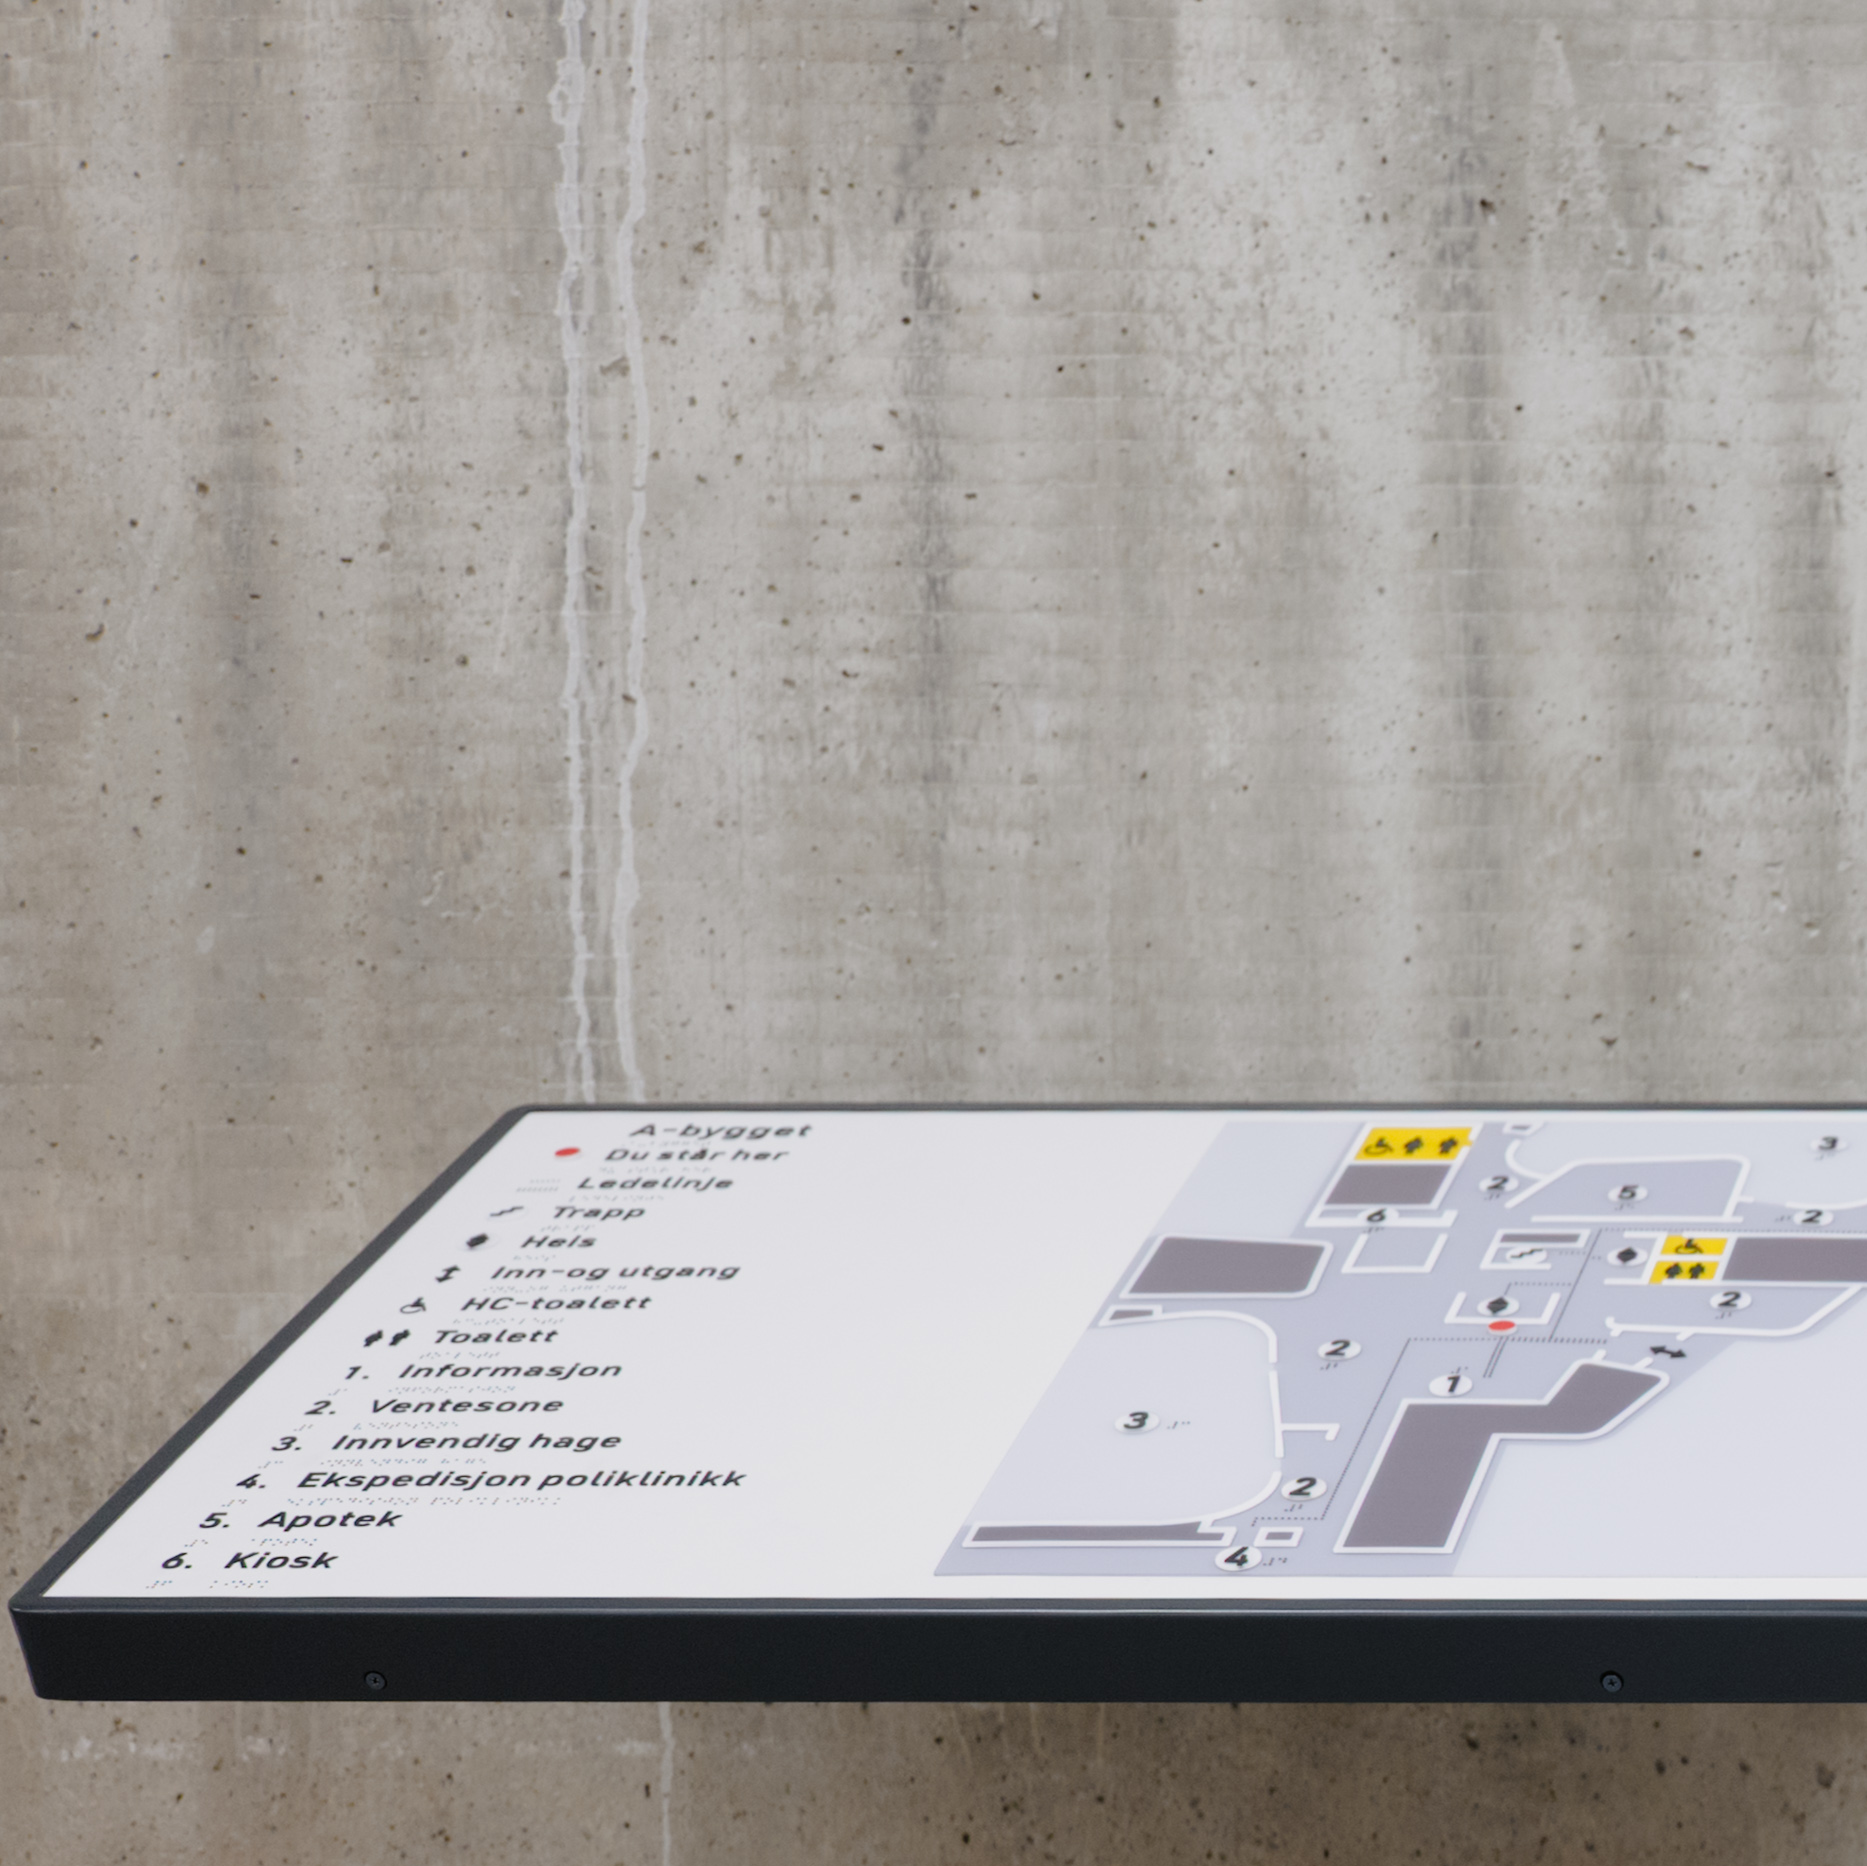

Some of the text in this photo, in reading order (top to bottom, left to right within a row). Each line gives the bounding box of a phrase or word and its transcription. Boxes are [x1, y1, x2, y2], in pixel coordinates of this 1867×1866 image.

[630, 1124, 811, 1140] A-bygget
[1819, 1136, 1839, 1151] 3
[604, 1147, 790, 1162] Du står her
[577, 1177, 733, 1192] Ledelinje
[1487, 1175, 1509, 1192] 2
[1618, 1184, 1638, 1201] 5
[554, 1206, 645, 1221] Trapp
[1366, 1208, 1386, 1223] 6
[1801, 1209, 1823, 1224] 2
[521, 1235, 595, 1248] Heis
[491, 1265, 740, 1281] Inn-og utgang
[461, 1296, 651, 1311] HC-toalett
[1718, 1290, 1742, 1307] 2
[435, 1329, 558, 1344] Toalett
[1325, 1339, 1351, 1357] 2
[345, 1362, 622, 1381] 1. Informasjon
[1446, 1374, 1462, 1394] 1
[304, 1399, 564, 1416] 2. Ventesone
[1123, 1411, 1149, 1430] 3
[271, 1433, 622, 1453] 3. Innvendig hage
[236, 1470, 746, 1492] 4. Ekspedisjon poliklinikk
[1288, 1476, 1317, 1497] 2
[199, 1510, 402, 1533] 5. Apotek
[161, 1551, 338, 1570] 6. Kiosk
[1223, 1546, 1249, 1568] 4
